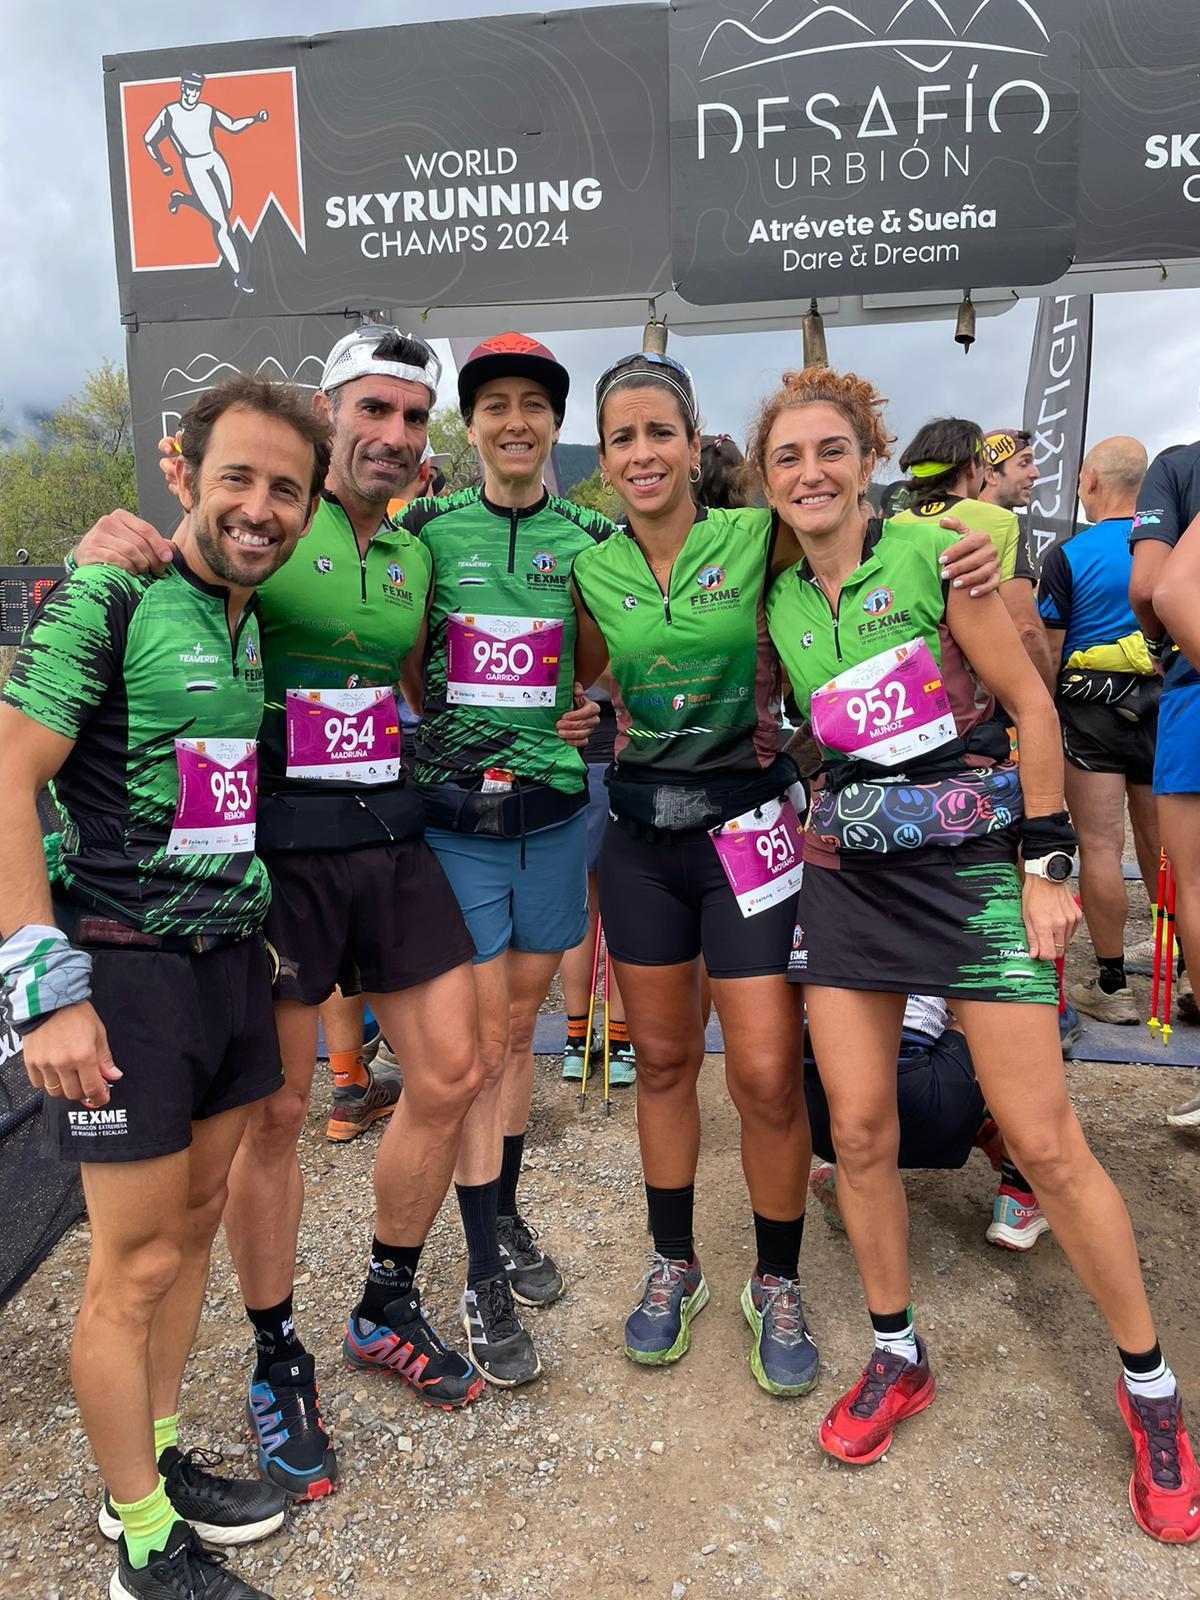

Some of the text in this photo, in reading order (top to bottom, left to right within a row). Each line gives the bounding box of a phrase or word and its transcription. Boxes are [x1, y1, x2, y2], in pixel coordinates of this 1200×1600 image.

[697, 64, 1051, 159] DESAFÍO
[405, 147, 518, 180] WORLD
[775, 138, 969, 190] URBIÓN
[325, 177, 603, 228] SKYRUNNING
[360, 220, 569, 259] CHAMPS 2024
[748, 203, 997, 243] Atrévete & Sueña
[783, 240, 959, 272] Dare & Dream
[382, 583, 414, 602] FEXME
[526, 573, 567, 584] FEXME
[690, 587, 740, 606] FEXME
[857, 609, 911, 635] FEXME
[473, 641, 534, 675] 950
[486, 673, 520, 682] GARRIDO
[846, 680, 915, 736] 952
[324, 716, 375, 753] 954
[331, 749, 368, 760] MADRUÑA
[210, 771, 252, 813] 953
[223, 811, 246, 821] REMÓN
[756, 823, 795, 869] 951
[770, 855, 795, 875] MOYANO
[68, 1109, 128, 1124] FEXME
